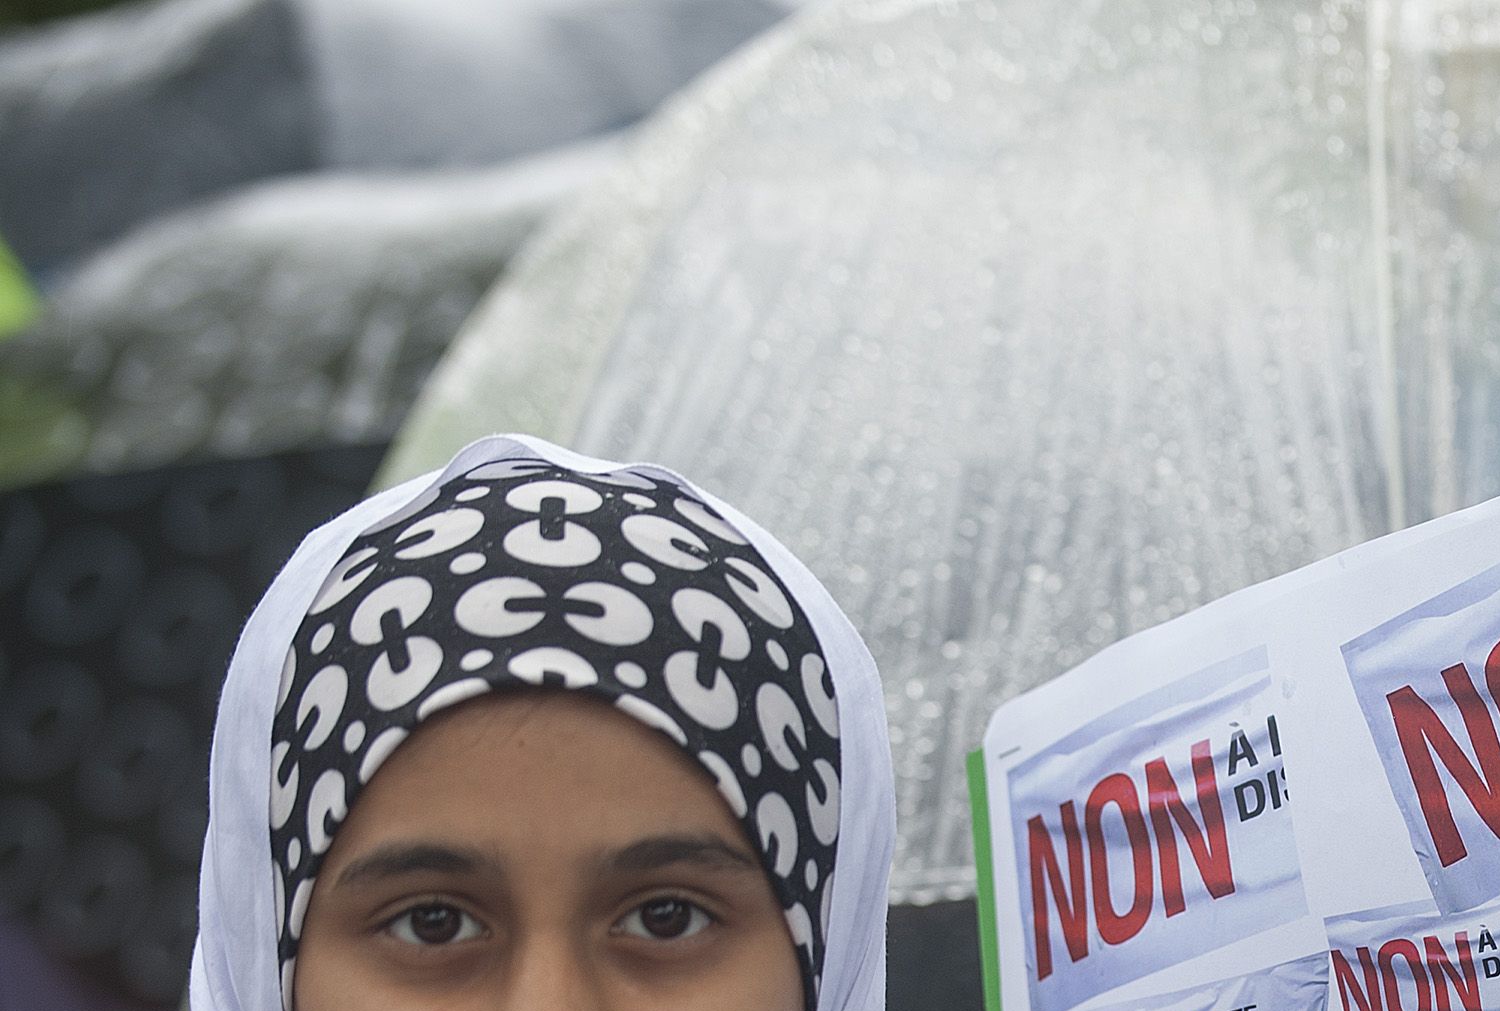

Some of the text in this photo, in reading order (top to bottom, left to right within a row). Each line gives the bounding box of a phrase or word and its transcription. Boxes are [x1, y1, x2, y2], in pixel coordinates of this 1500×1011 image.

[1228, 722, 1258, 776] À
[1234, 767, 1289, 822] DI
[1027, 738, 1235, 981] NON
[1478, 924, 1497, 953] À
